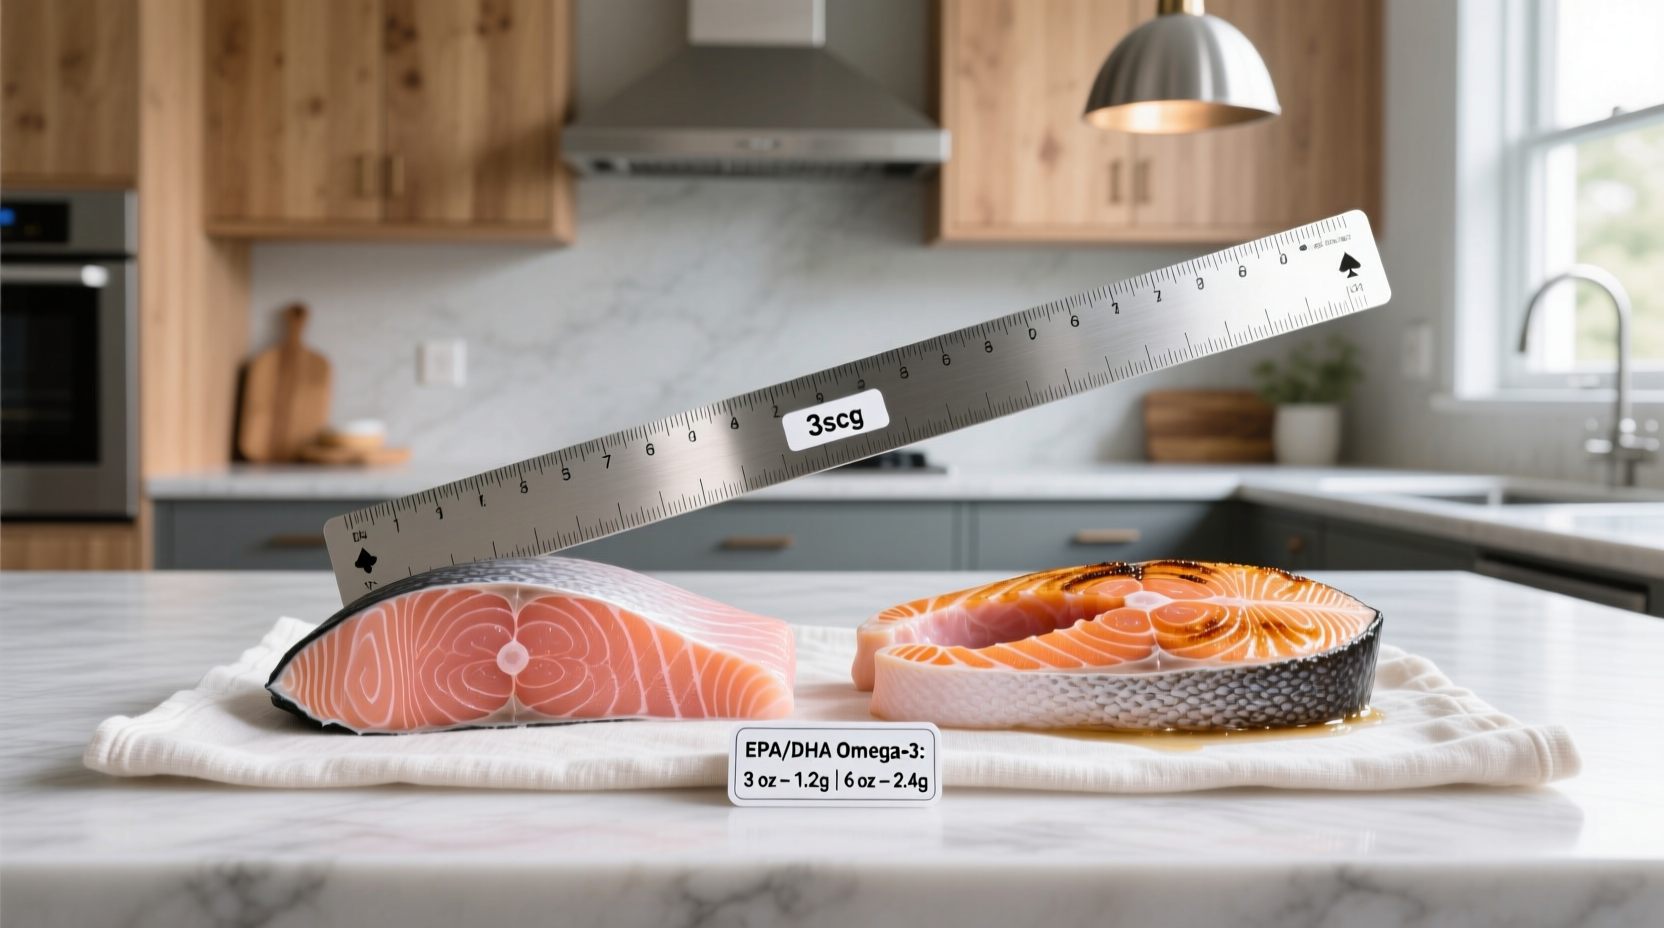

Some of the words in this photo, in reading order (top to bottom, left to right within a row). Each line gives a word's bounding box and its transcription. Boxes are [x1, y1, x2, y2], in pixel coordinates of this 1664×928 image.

[602, 454, 611, 469] 7
[645, 443, 655, 456] 6
[772, 405, 783, 419] 2
[1070, 315, 1080, 327] 6
[1279, 253, 1288, 265] 0
[806, 408, 864, 437] 3scg
[745, 740, 832, 762] EPA/DHA
[836, 741, 925, 764] Omega-3:
[743, 771, 754, 788] 3
[758, 775, 777, 788] oz
[794, 771, 829, 792] 1.2g
[844, 771, 854, 788] 6
[857, 775, 876, 788] oz
[893, 772, 928, 793] 2.4g
